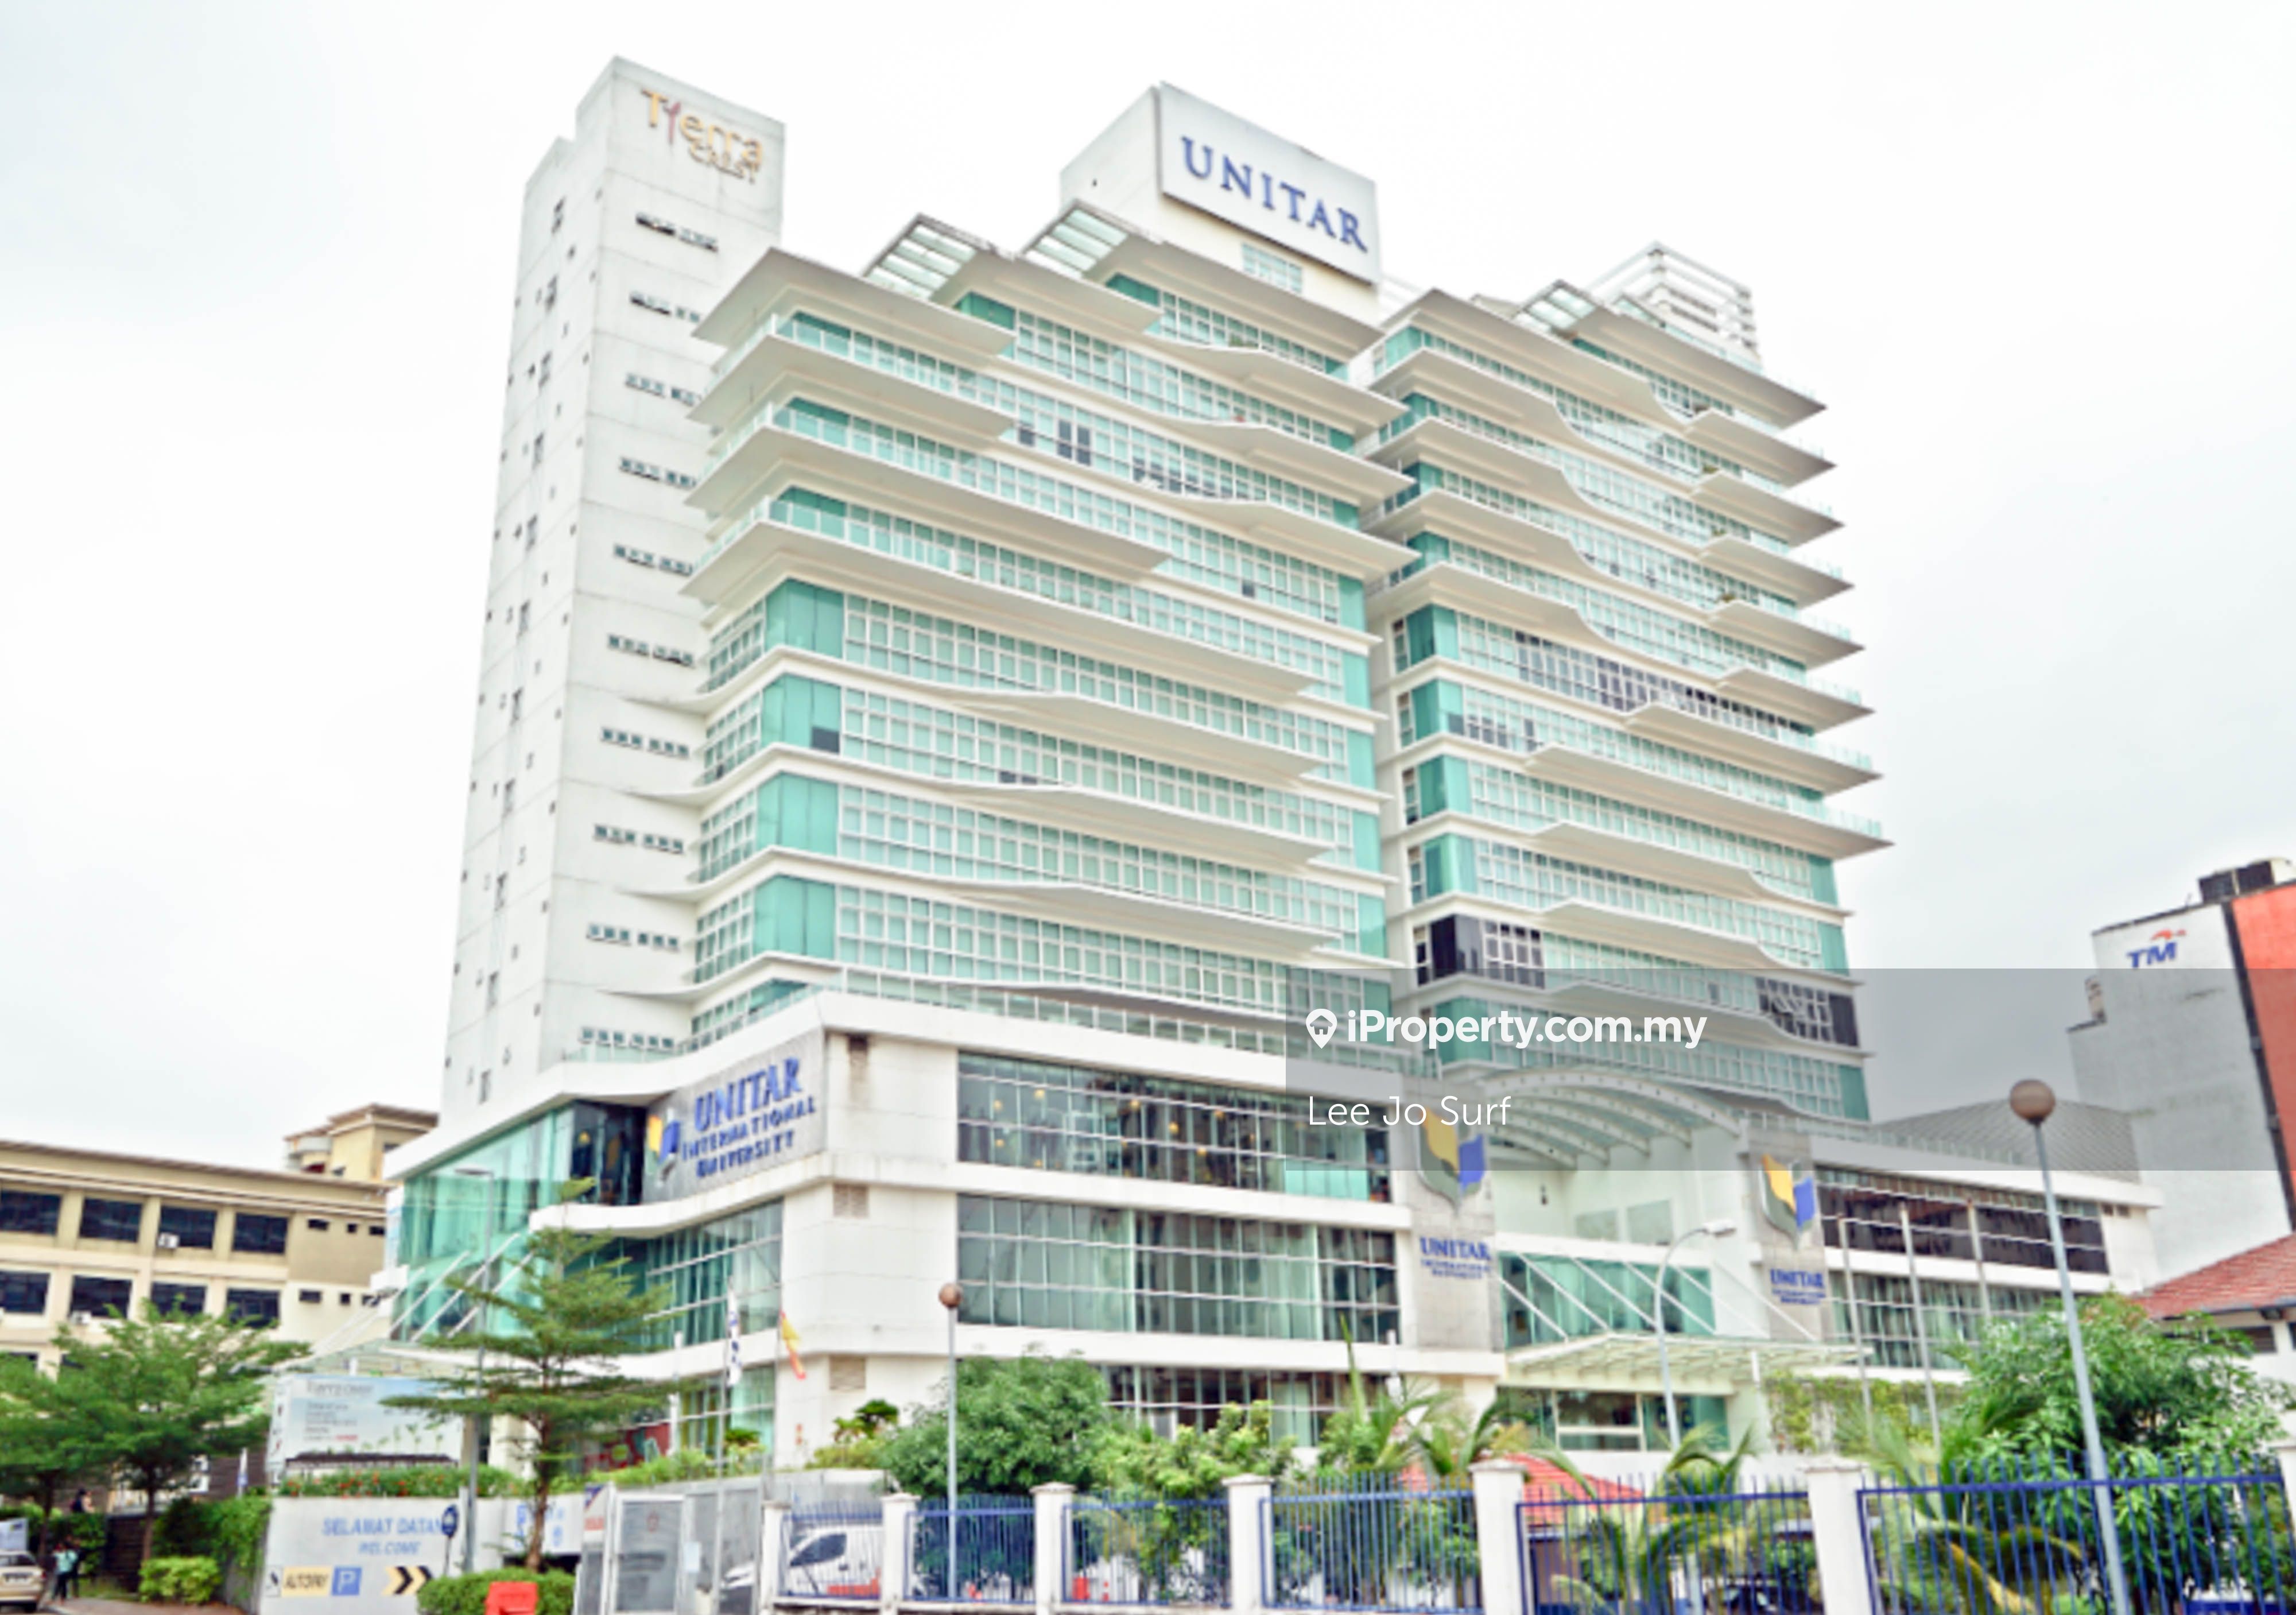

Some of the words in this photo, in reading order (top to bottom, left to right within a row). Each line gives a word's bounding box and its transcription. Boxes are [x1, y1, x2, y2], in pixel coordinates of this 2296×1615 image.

[1180, 135, 1368, 253] UNITAR
[2127, 941, 2177, 969] TM
[694, 1056, 802, 1132] UNITAR
[681, 1095, 816, 1161] INTERNATIONAL
[696, 1129, 794, 1179] UNIVERSITY
[1420, 1236, 1491, 1261] UNITAR
